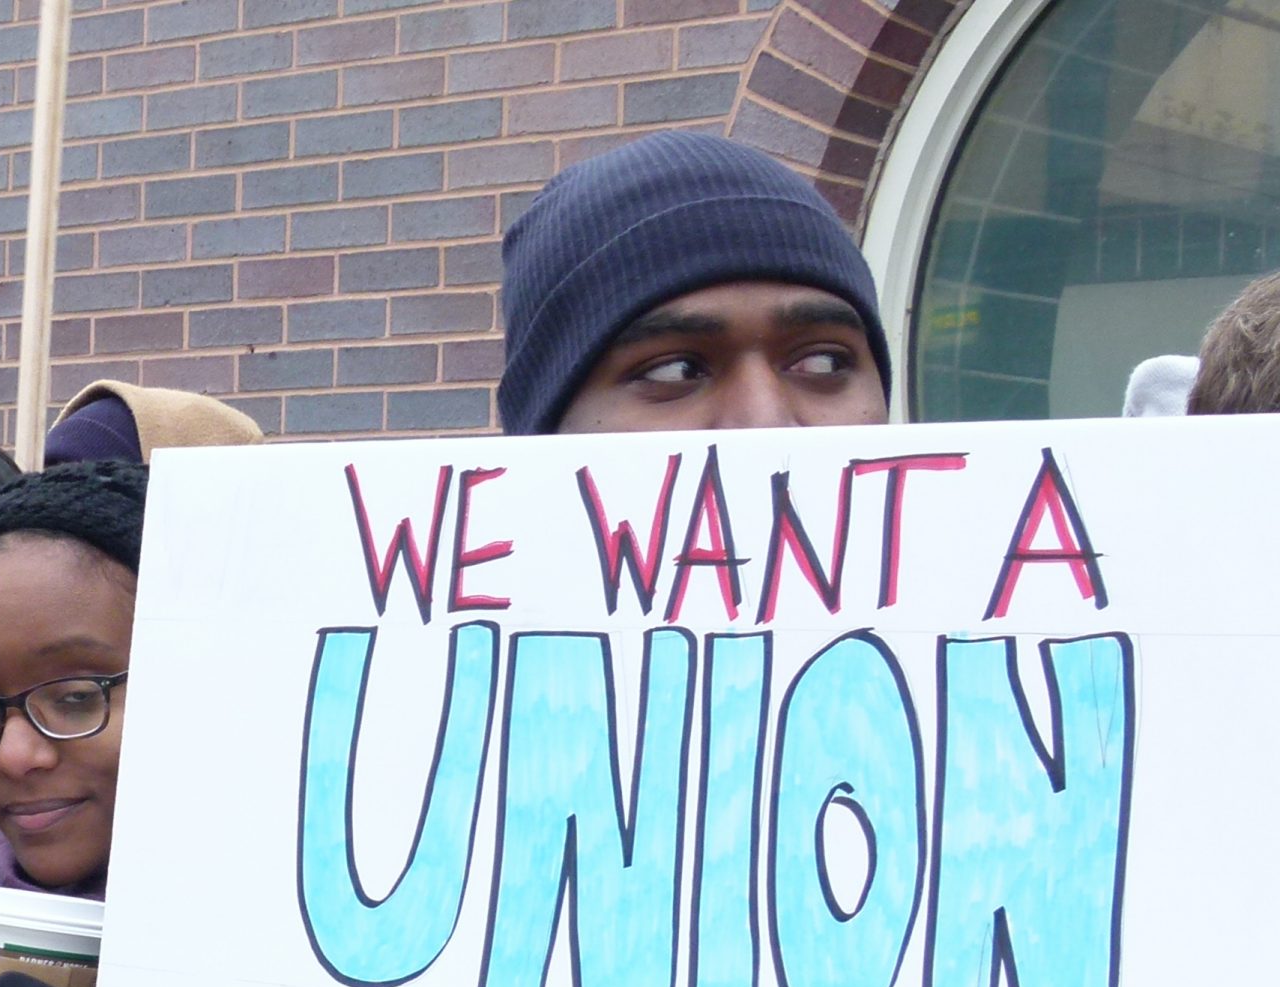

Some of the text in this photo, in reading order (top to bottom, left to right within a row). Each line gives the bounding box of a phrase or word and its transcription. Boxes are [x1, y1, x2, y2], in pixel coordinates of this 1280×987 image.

[344, 444, 1109, 625] WE WANT A
